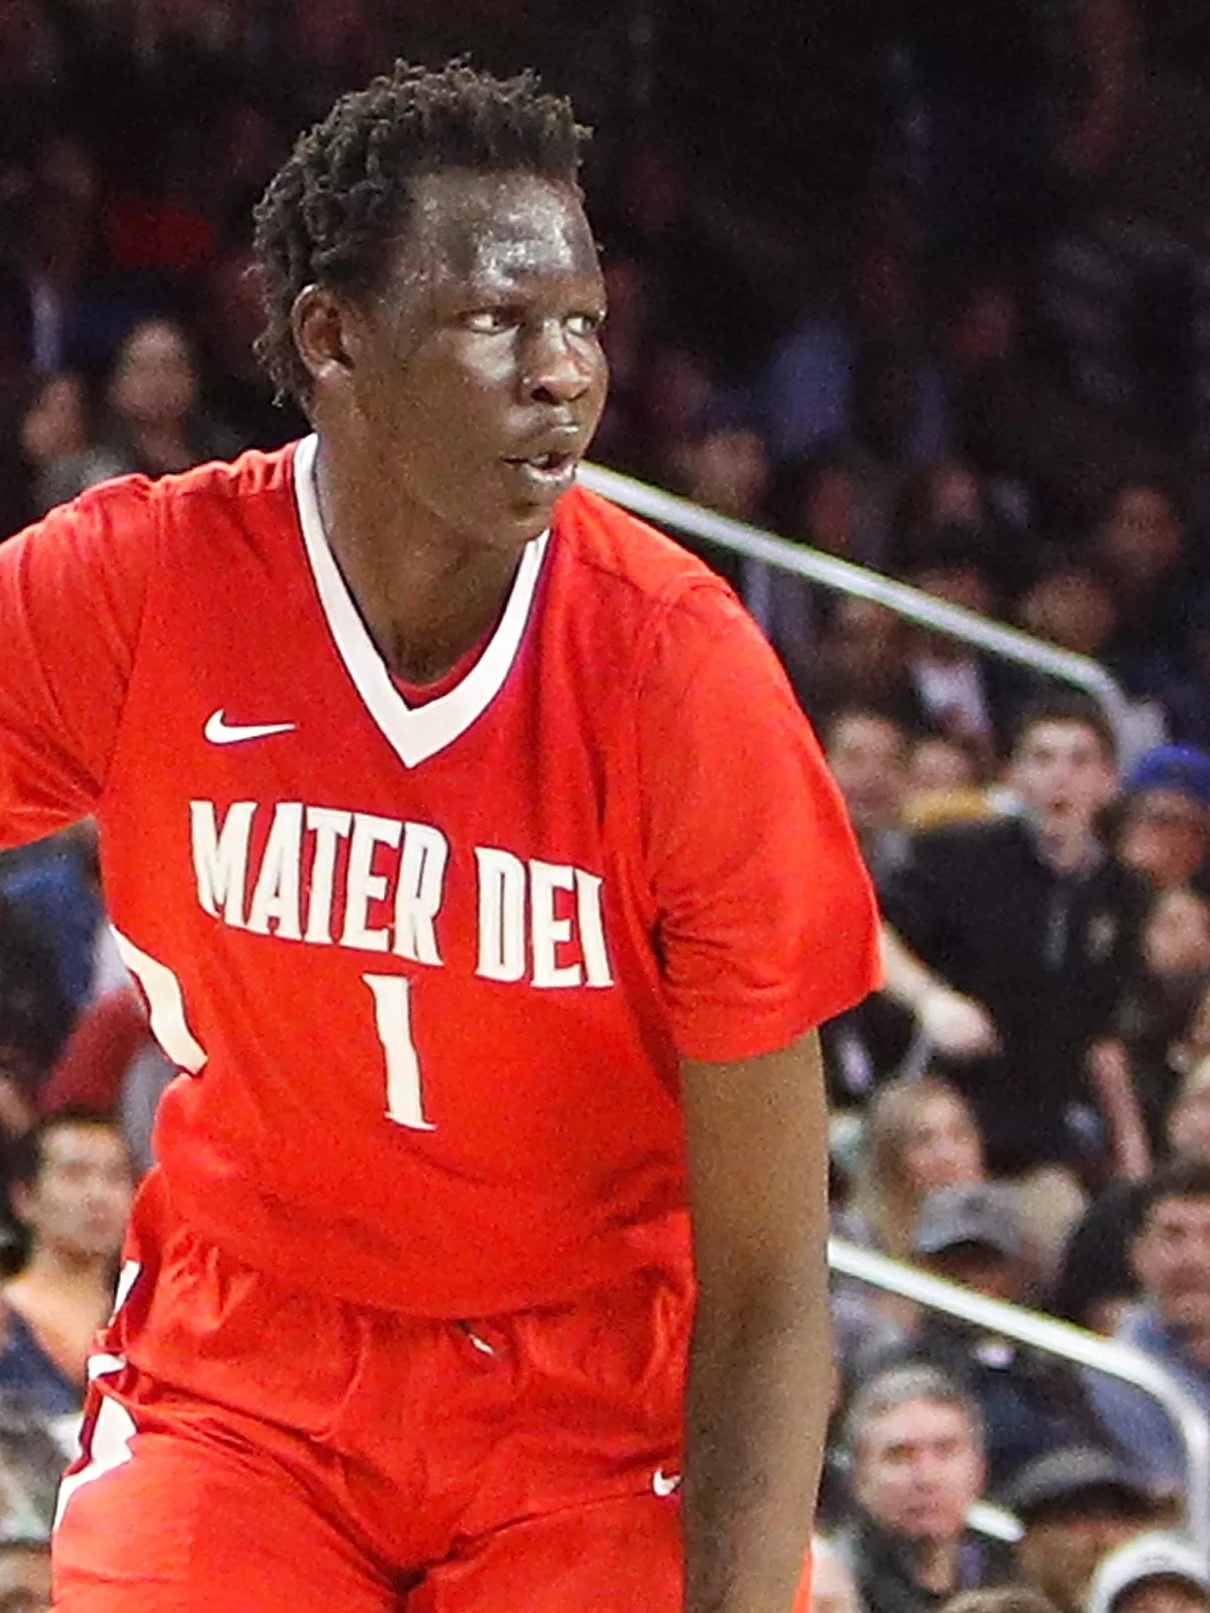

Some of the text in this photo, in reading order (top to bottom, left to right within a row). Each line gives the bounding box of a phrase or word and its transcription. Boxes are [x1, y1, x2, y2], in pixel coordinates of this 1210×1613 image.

[190, 799, 614, 988] MATER DEI
[362, 973, 437, 1131] 1
